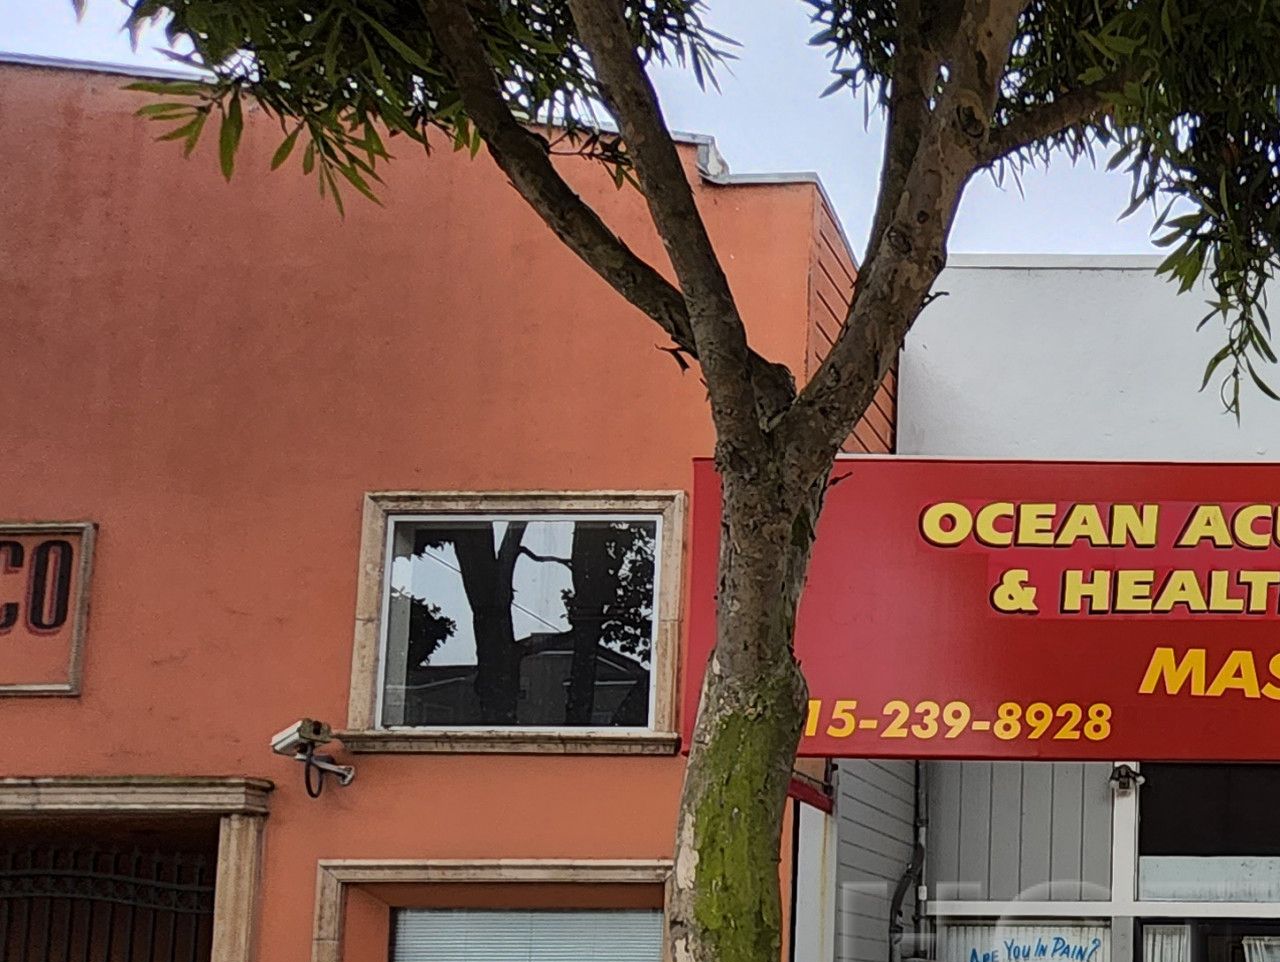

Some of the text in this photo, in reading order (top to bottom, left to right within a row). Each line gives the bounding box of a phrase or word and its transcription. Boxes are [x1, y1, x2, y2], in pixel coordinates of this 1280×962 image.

[921, 502, 1159, 548] OCEAN
[989, 569, 1039, 614] &
[804, 699, 1113, 741] 15-239-8928
